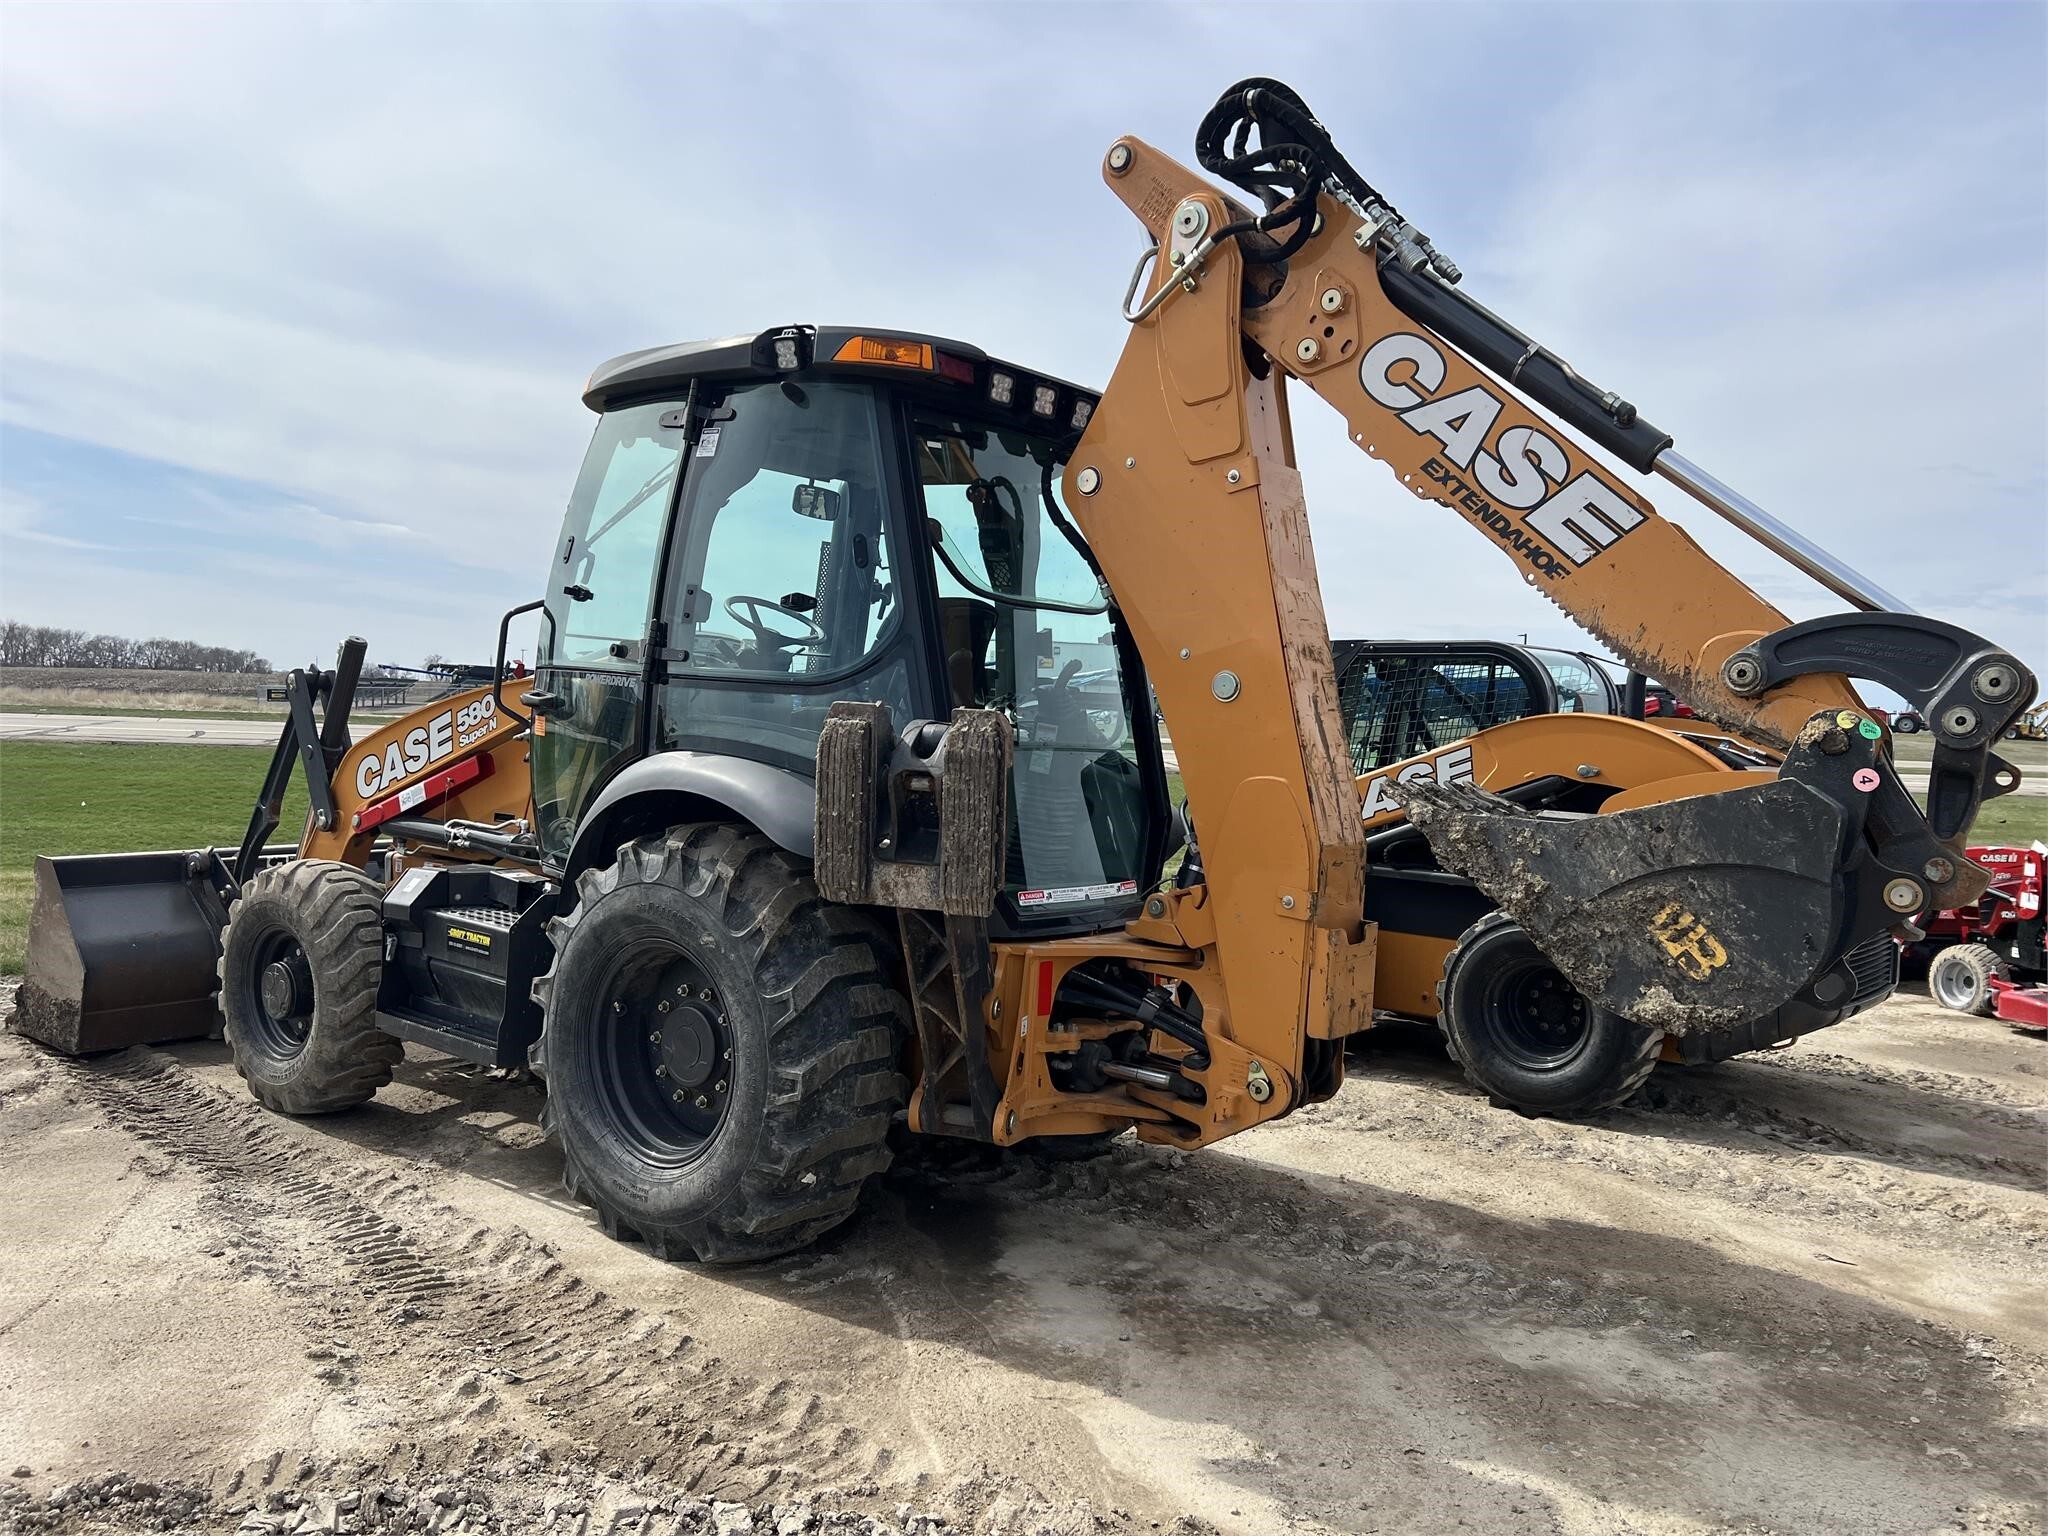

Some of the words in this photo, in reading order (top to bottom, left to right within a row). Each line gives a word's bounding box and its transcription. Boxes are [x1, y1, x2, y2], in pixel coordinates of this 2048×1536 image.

[1359, 332, 1649, 568] CASE
[585, 673, 636, 687] POWERDRIVE
[356, 709, 453, 799] CASE
[456, 693, 496, 733] 580
[459, 724, 488, 747] Super
[489, 716, 497, 732] N
[1362, 745, 1474, 820] ASE
[1859, 775, 1874, 785] 4
[1980, 854, 2007, 863] CASE
